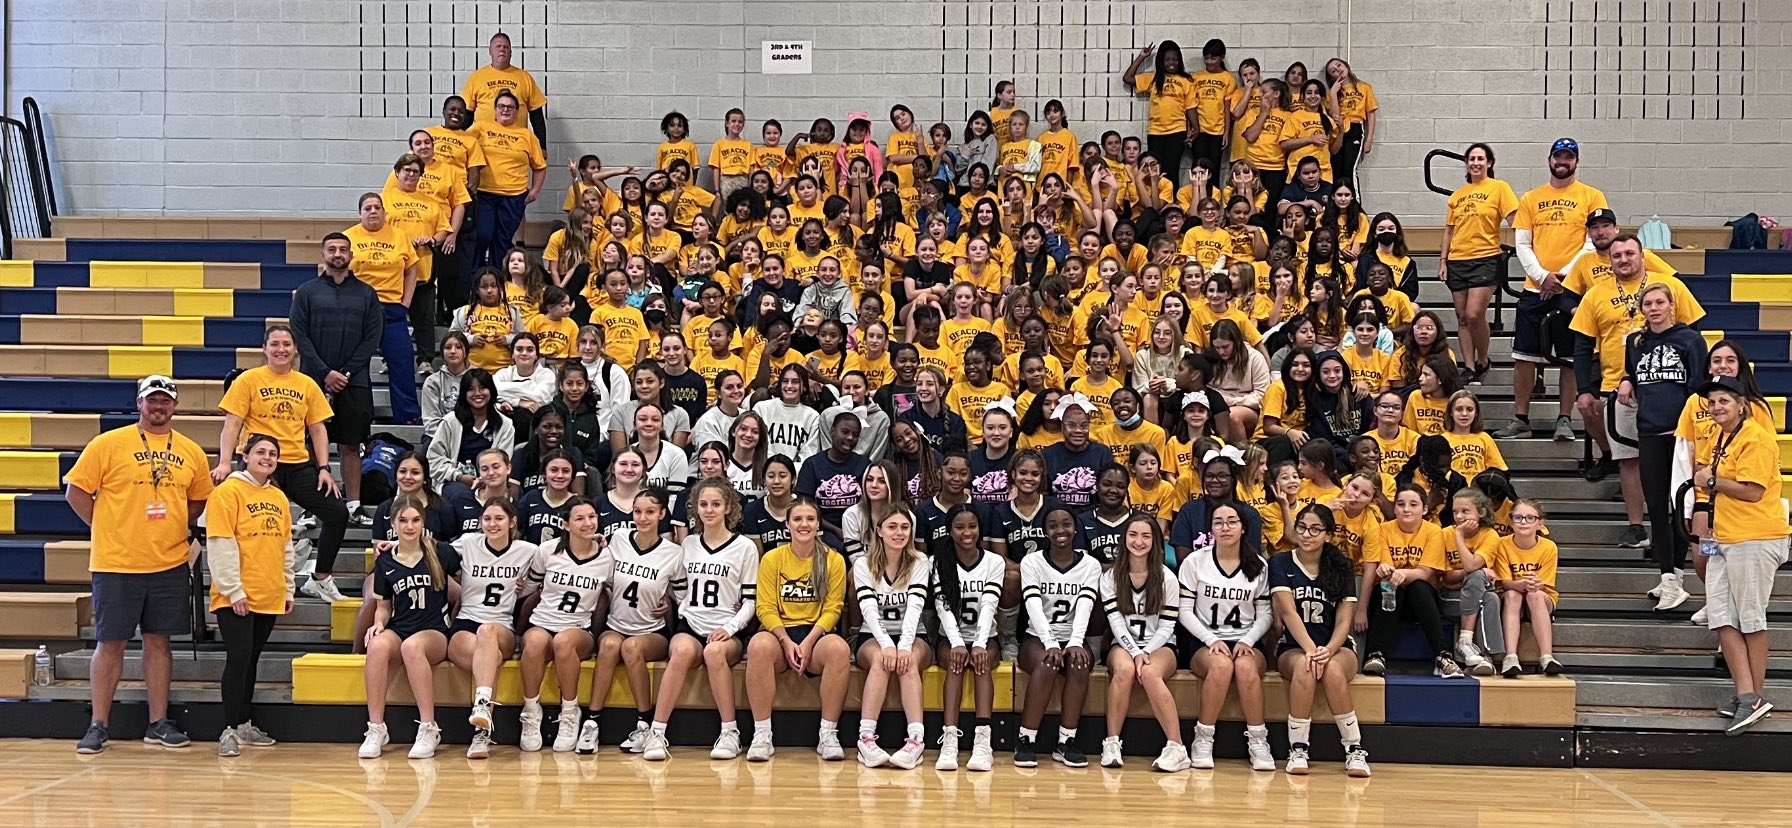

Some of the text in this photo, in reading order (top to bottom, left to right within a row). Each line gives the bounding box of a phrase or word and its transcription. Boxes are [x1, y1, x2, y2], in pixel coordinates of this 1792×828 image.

[486, 79, 518, 88] BEACON
[486, 130, 519, 142] BEACON
[661, 148, 689, 157] BEACON
[721, 147, 749, 158] BEACON
[1002, 149, 1028, 159] BEACON
[392, 202, 429, 211] BEACON
[1538, 198, 1578, 210] BEACON
[357, 241, 396, 250] BEACON
[1195, 240, 1224, 250] BEACON
[1610, 293, 1640, 306] BEAC
[604, 316, 640, 329] BEACON
[536, 331, 570, 343] BEACON
[949, 328, 981, 341] BEACO
[920, 357, 949, 369] EACON
[259, 387, 304, 401] BEACON
[1416, 408, 1446, 418] BEAC
[133, 451, 185, 467] BEACON
[246, 502, 284, 516] BEACON
[529, 513, 564, 530] BEACO
[604, 520, 637, 536] BEAC
[761, 529, 790, 544] BEAC
[1008, 527, 1045, 544] BEACO
[1091, 534, 1121, 550] BEAC
[1334, 523, 1364, 546] EACON
[472, 565, 520, 579] BEACON
[615, 560, 659, 581] BEACON
[687, 562, 730, 578] BEACON
[393, 574, 431, 595] BEACO
[552, 571, 599, 591] BEACON
[408, 588, 427, 610] 11
[482, 582, 505, 607] 6
[622, 581, 639, 608] 4
[689, 579, 720, 608] 18
[780, 584, 815, 598] PAC
[1204, 585, 1251, 601] BEACON
[558, 591, 581, 614] 8
[961, 597, 979, 625] 5
[1053, 599, 1072, 625] 2
[1210, 602, 1242, 630] 14
[1301, 600, 1324, 624] 12
[1129, 619, 1146, 641] 7
